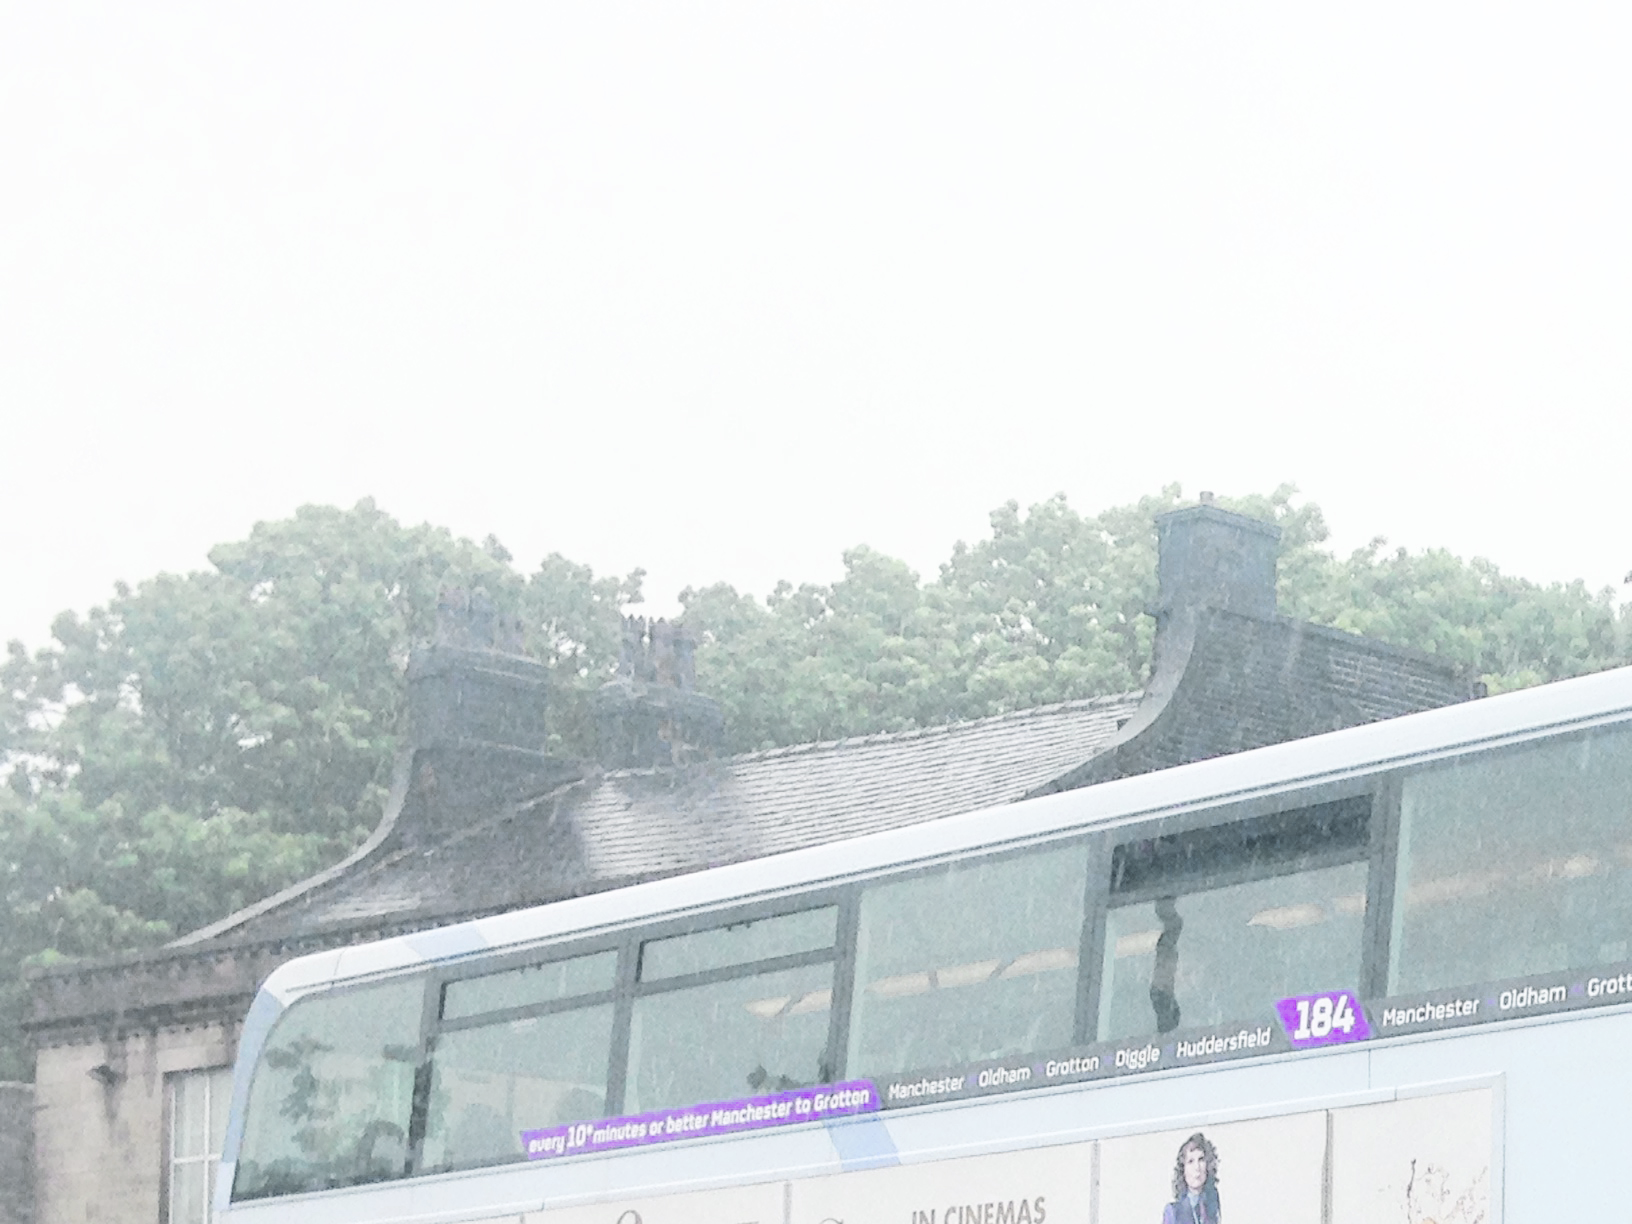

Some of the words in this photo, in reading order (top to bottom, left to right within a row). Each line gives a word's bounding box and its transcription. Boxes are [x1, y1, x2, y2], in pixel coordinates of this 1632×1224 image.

[1293, 995, 1355, 1040] 184
[1382, 998, 1480, 1027] Manchester
[1499, 985, 1566, 1010] Oldham
[888, 1075, 965, 1099] Manchester
[978, 1065, 1031, 1087] Oldham
[1046, 1056, 1099, 1077] Grotton
[1116, 1045, 1161, 1069] Diggle
[1176, 1027, 1271, 1058] Huddersfield
[528, 1134, 566, 1153] every
[592, 1124, 646, 1144] minutes
[649, 1120, 664, 1136] or
[666, 1114, 709, 1133] better
[711, 1101, 792, 1127] Manchester
[795, 1099, 810, 1114] to
[813, 1089, 870, 1112] Grotton
